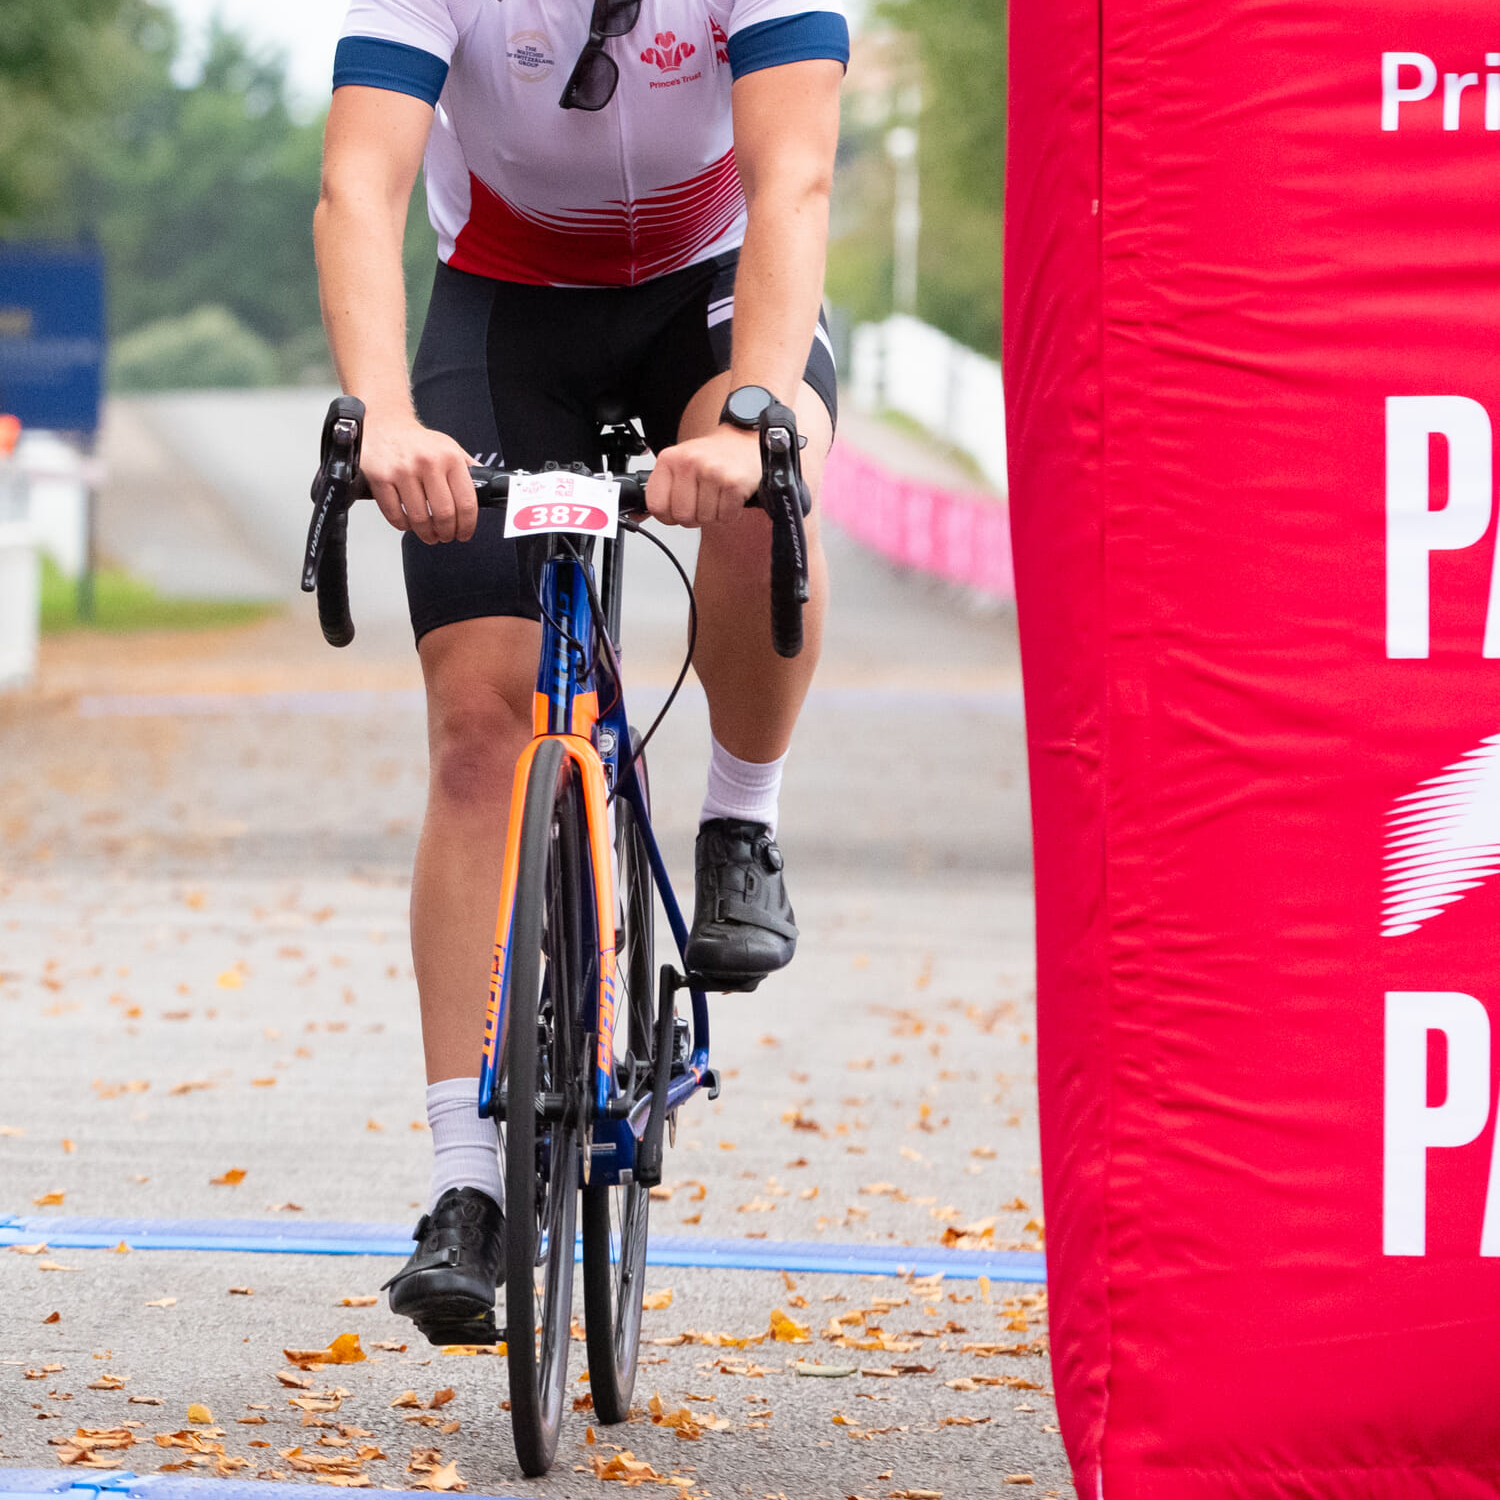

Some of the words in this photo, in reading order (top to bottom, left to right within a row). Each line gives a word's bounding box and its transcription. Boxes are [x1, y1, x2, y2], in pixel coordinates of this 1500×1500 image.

[650, 78, 681, 89] Prince's
[310, 485, 335, 558] ULTEGRA
[529, 505, 591, 526] 387
[782, 495, 803, 569] ULTEGRA
